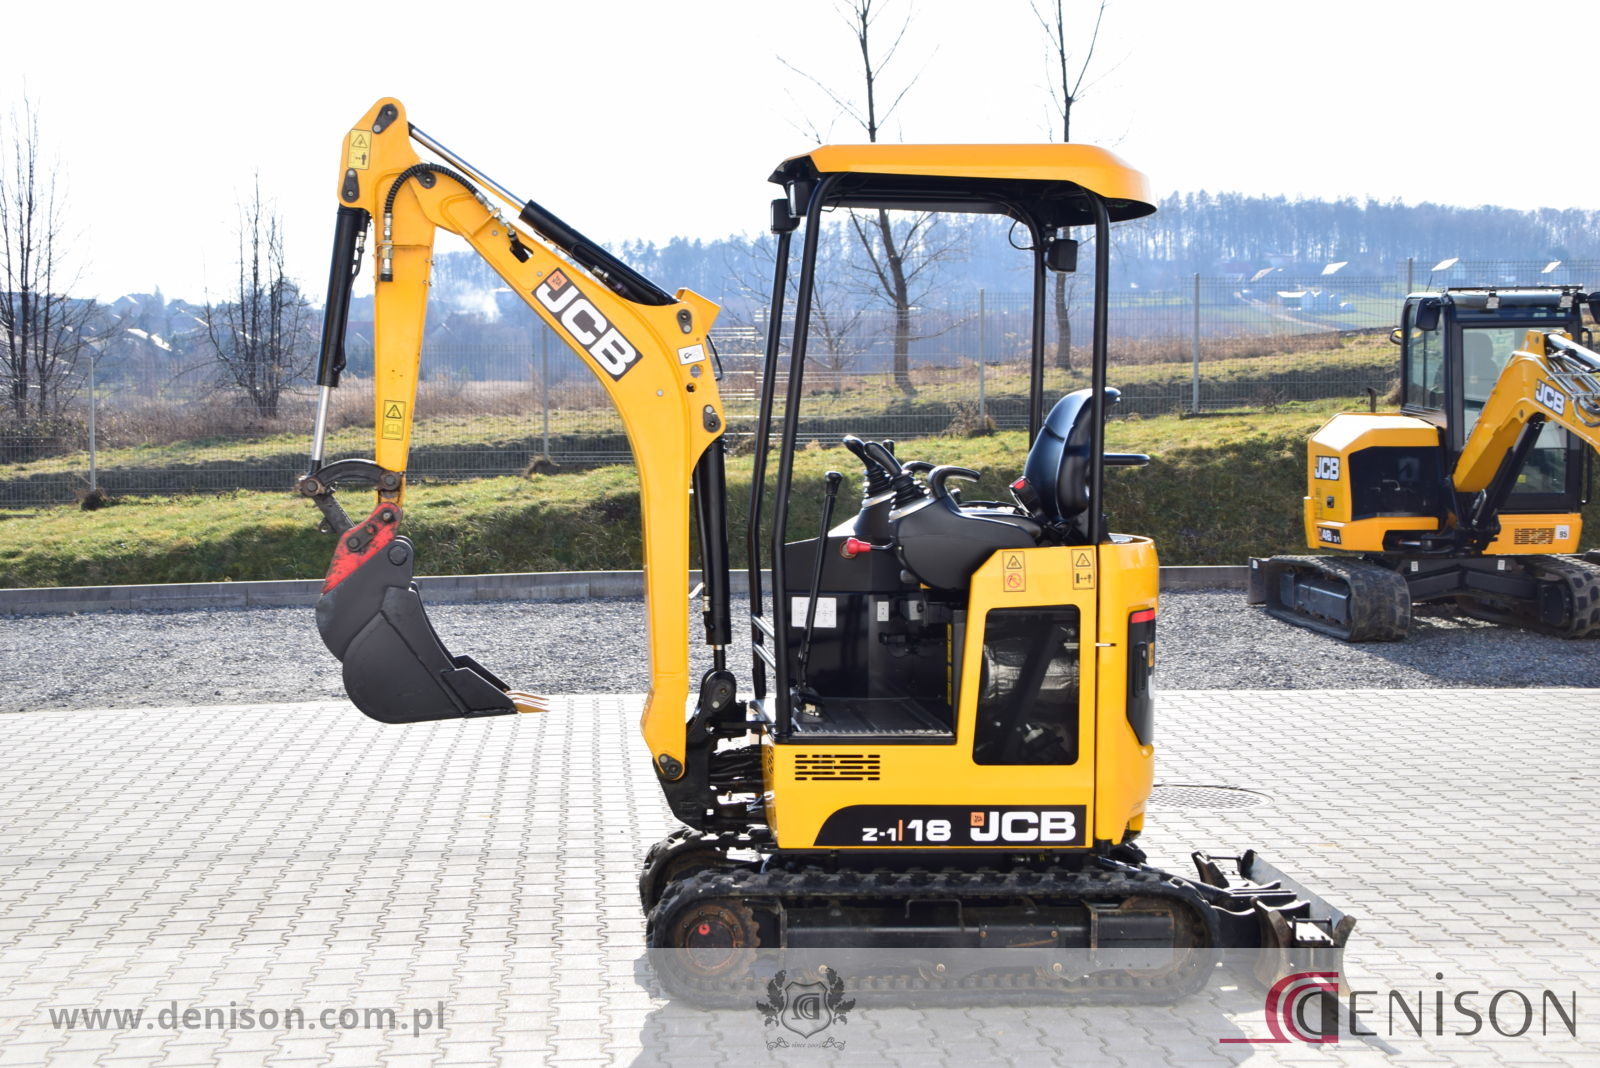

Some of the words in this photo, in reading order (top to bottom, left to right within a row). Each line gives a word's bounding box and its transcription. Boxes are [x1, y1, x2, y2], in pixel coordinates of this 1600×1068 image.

[536, 281, 637, 376] JCB
[1535, 383, 1565, 415] JCB
[1315, 456, 1340, 481] JCB
[970, 811, 1076, 842] JCB
